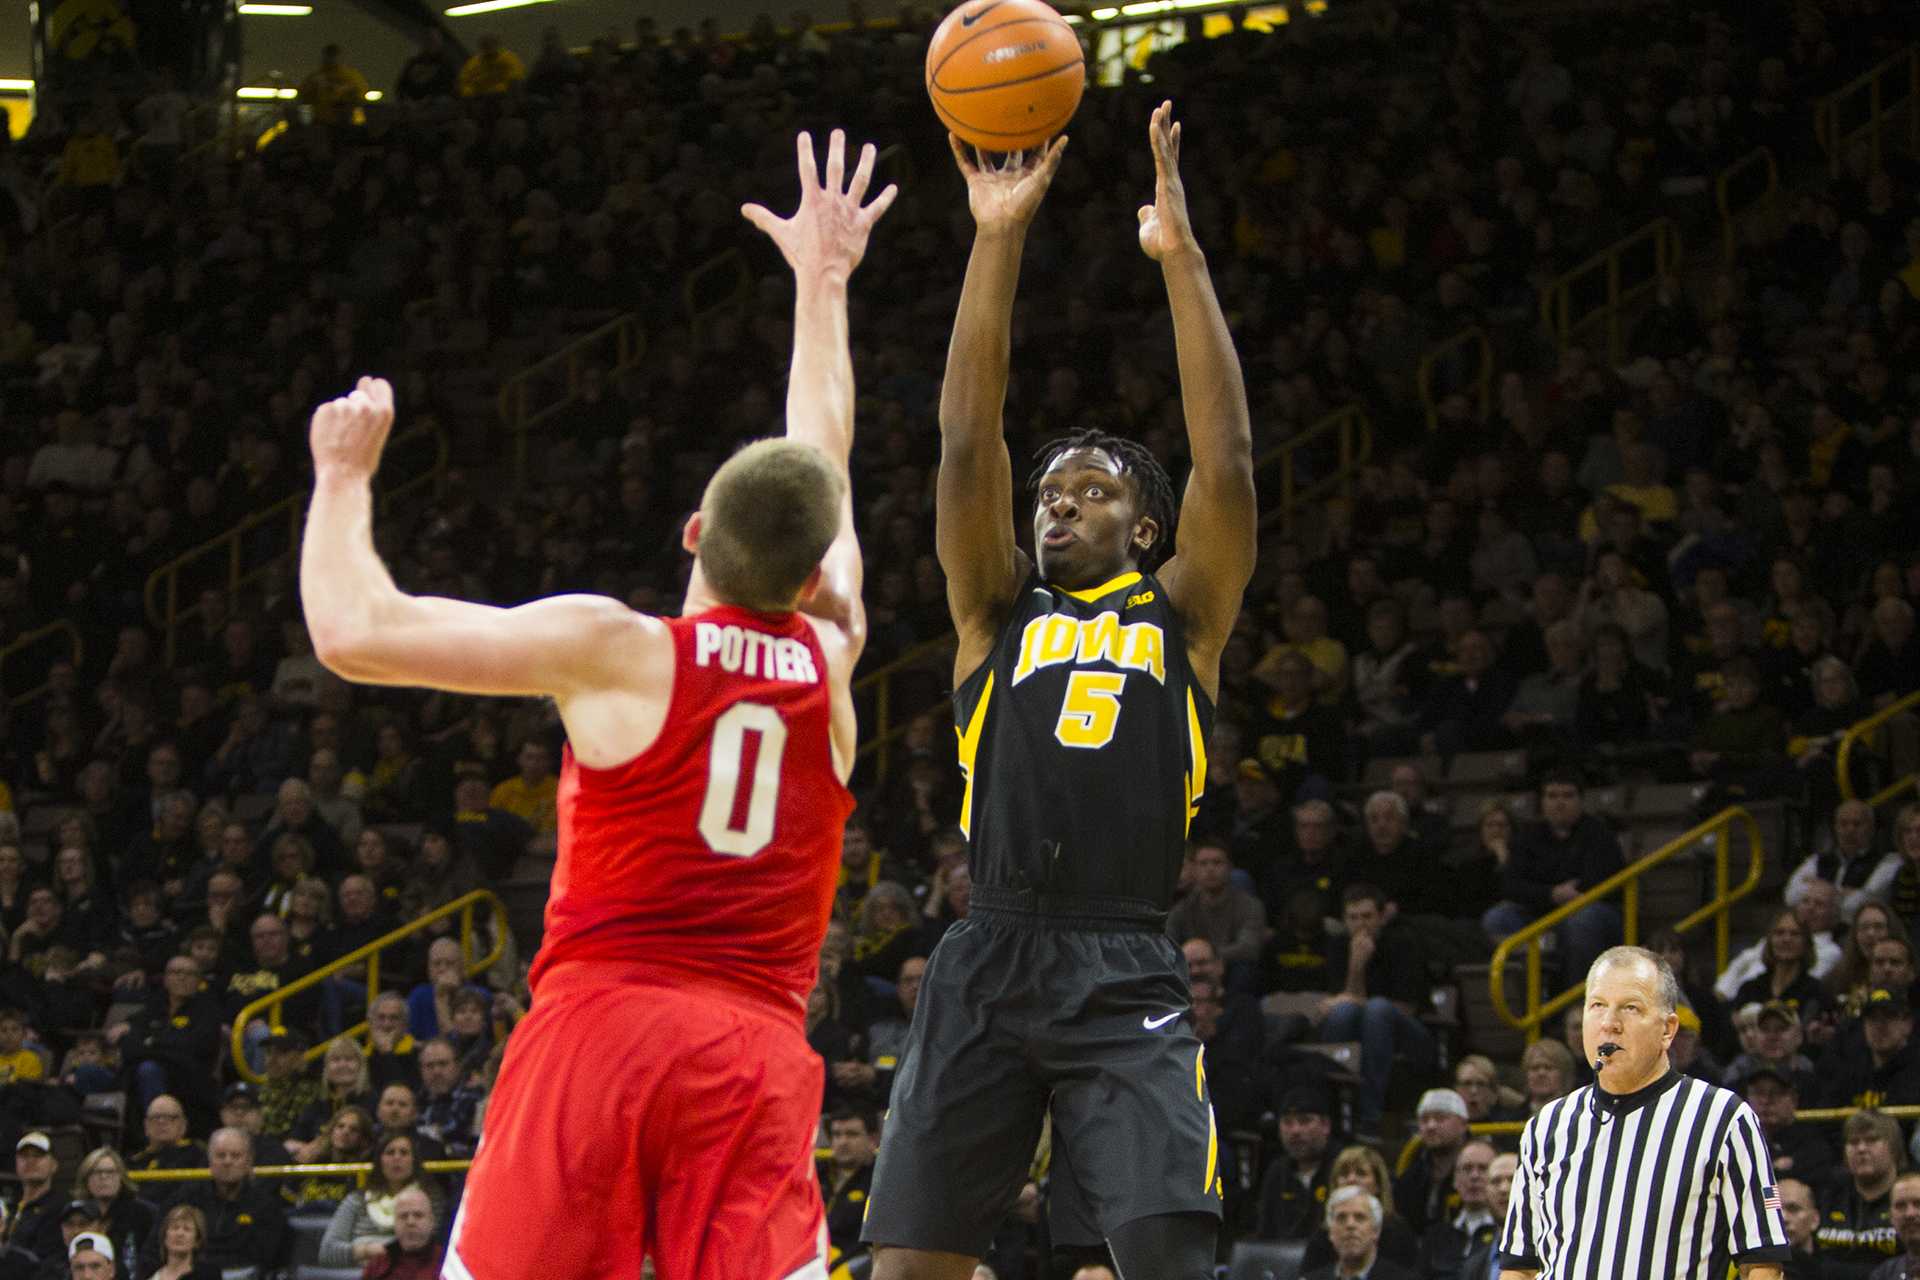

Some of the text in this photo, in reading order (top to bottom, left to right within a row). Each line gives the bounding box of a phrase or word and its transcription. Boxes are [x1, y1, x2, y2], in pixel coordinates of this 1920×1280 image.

[695, 622, 819, 684] POTTER
[1011, 611, 1166, 687] IOWA
[1054, 671, 1127, 749] 5
[697, 700, 789, 858] 0
